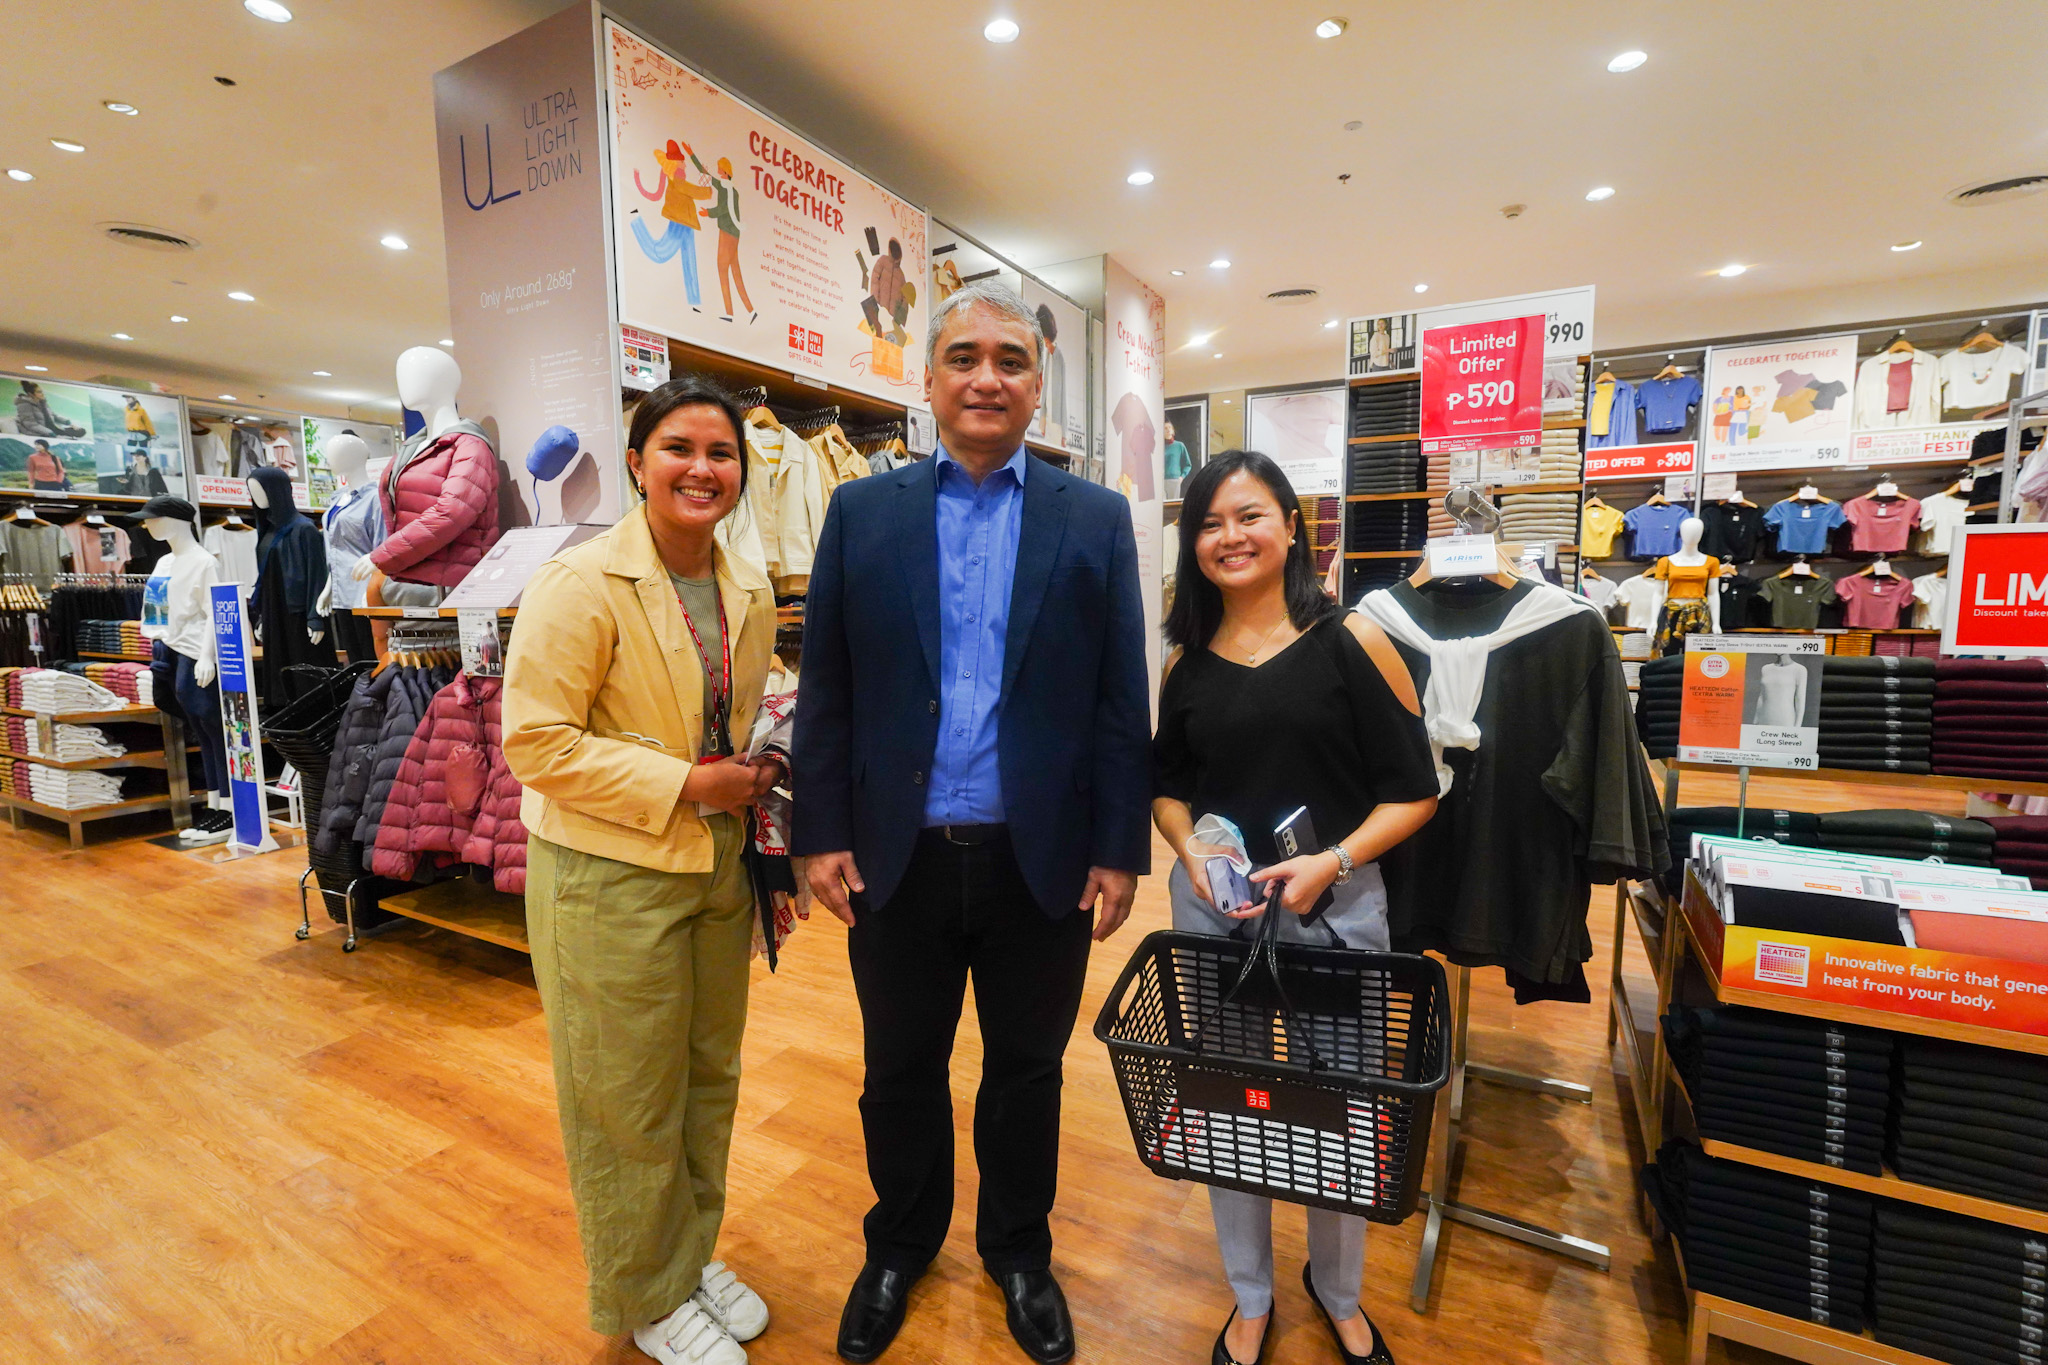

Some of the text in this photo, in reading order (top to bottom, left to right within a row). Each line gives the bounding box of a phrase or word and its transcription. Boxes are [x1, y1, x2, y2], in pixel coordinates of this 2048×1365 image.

[523, 87, 578, 129] ULTRA
[525, 117, 579, 161] LIGHT
[527, 149, 582, 192] DOWN
[749, 130, 845, 204] CELEBRATE
[750, 165, 845, 235] TOGETHER
[480, 290, 501, 309] Only
[504, 276, 542, 301] Around
[651, 338, 664, 346] OPEN
[809, 333, 821, 345] UNI
[1117, 320, 1155, 358] Crew Neck
[1450, 330, 1517, 355] Limited
[809, 342, 822, 354] QLO
[788, 351, 824, 368] GIFTS FOR ALL
[1727, 348, 1839, 367] CELEBRATE TOGETHER
[1124, 350, 1151, 381] T-shirt
[1458, 355, 1505, 375] Offer
[1924, 429, 1970, 442] THANK
[1923, 440, 1975, 454] FESTI
[1610, 456, 1646, 468] OFFER
[202, 484, 243, 495] OPENING
[1323, 479, 1338, 489] 790
[1444, 554, 1483, 562] AIRism
[1975, 573, 2048, 606] LIM
[216, 600, 237, 612] SPORT
[1973, 608, 2018, 617] Discount
[215, 612, 239, 624] UTILITY
[1778, 739, 1802, 747] Sleeve)
[1855, 886, 1862, 895] S
[1760, 947, 1806, 959] HEATTECH
[1775, 972, 1804, 981] TECHNOLOGY
[1825, 952, 1905, 976] Innovative
[1909, 963, 1960, 983] fabric
[1964, 971, 2000, 988] that
[1823, 972, 1996, 1012] heat from your body.
